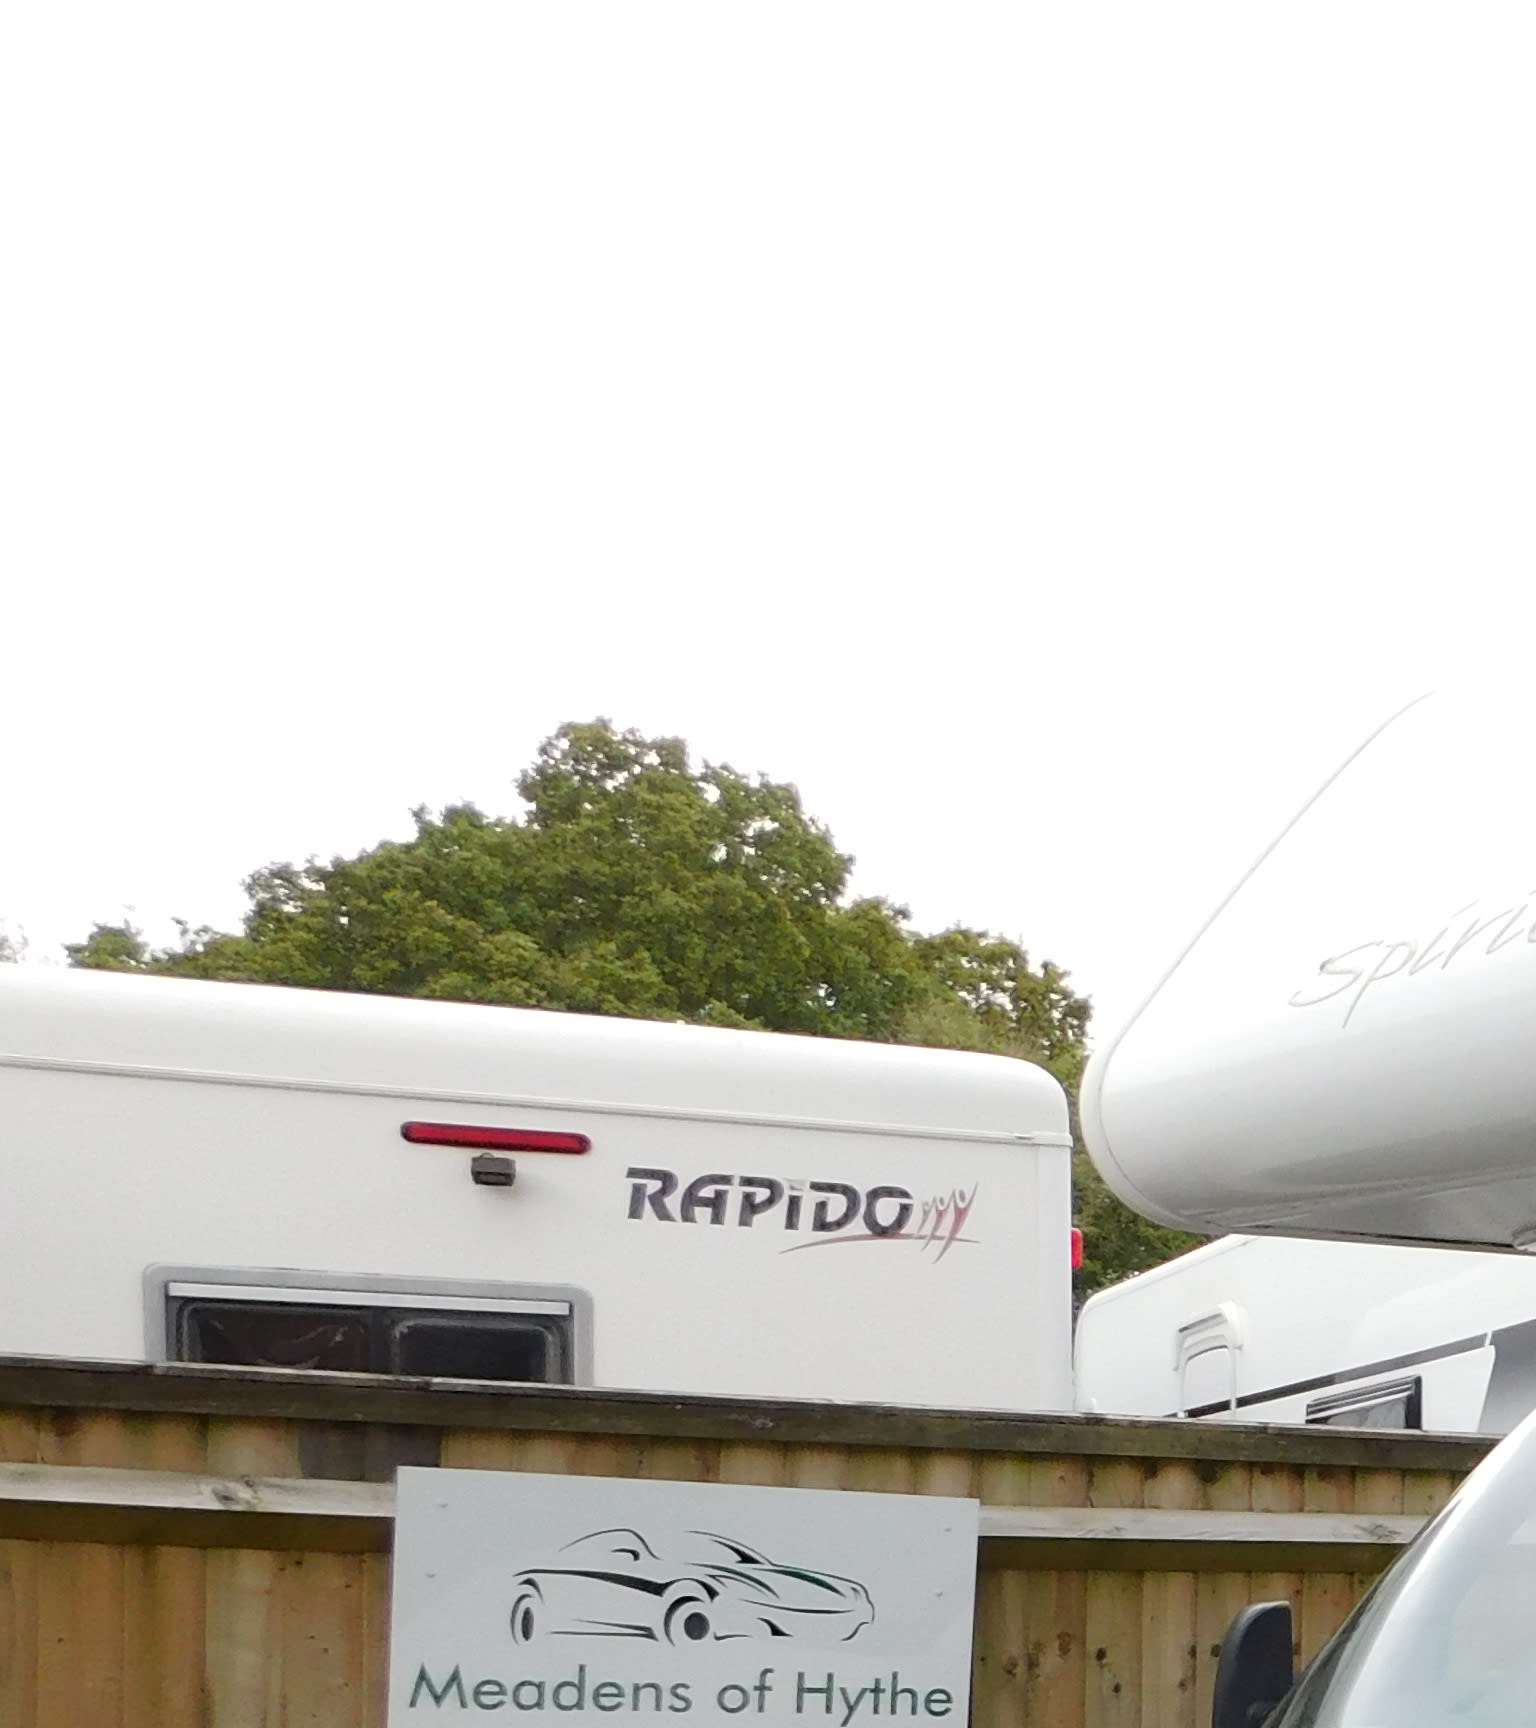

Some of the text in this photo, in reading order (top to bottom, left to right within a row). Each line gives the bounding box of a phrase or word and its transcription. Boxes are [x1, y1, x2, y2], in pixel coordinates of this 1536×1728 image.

[409, 1663, 954, 1727] Meadens of Hythe
